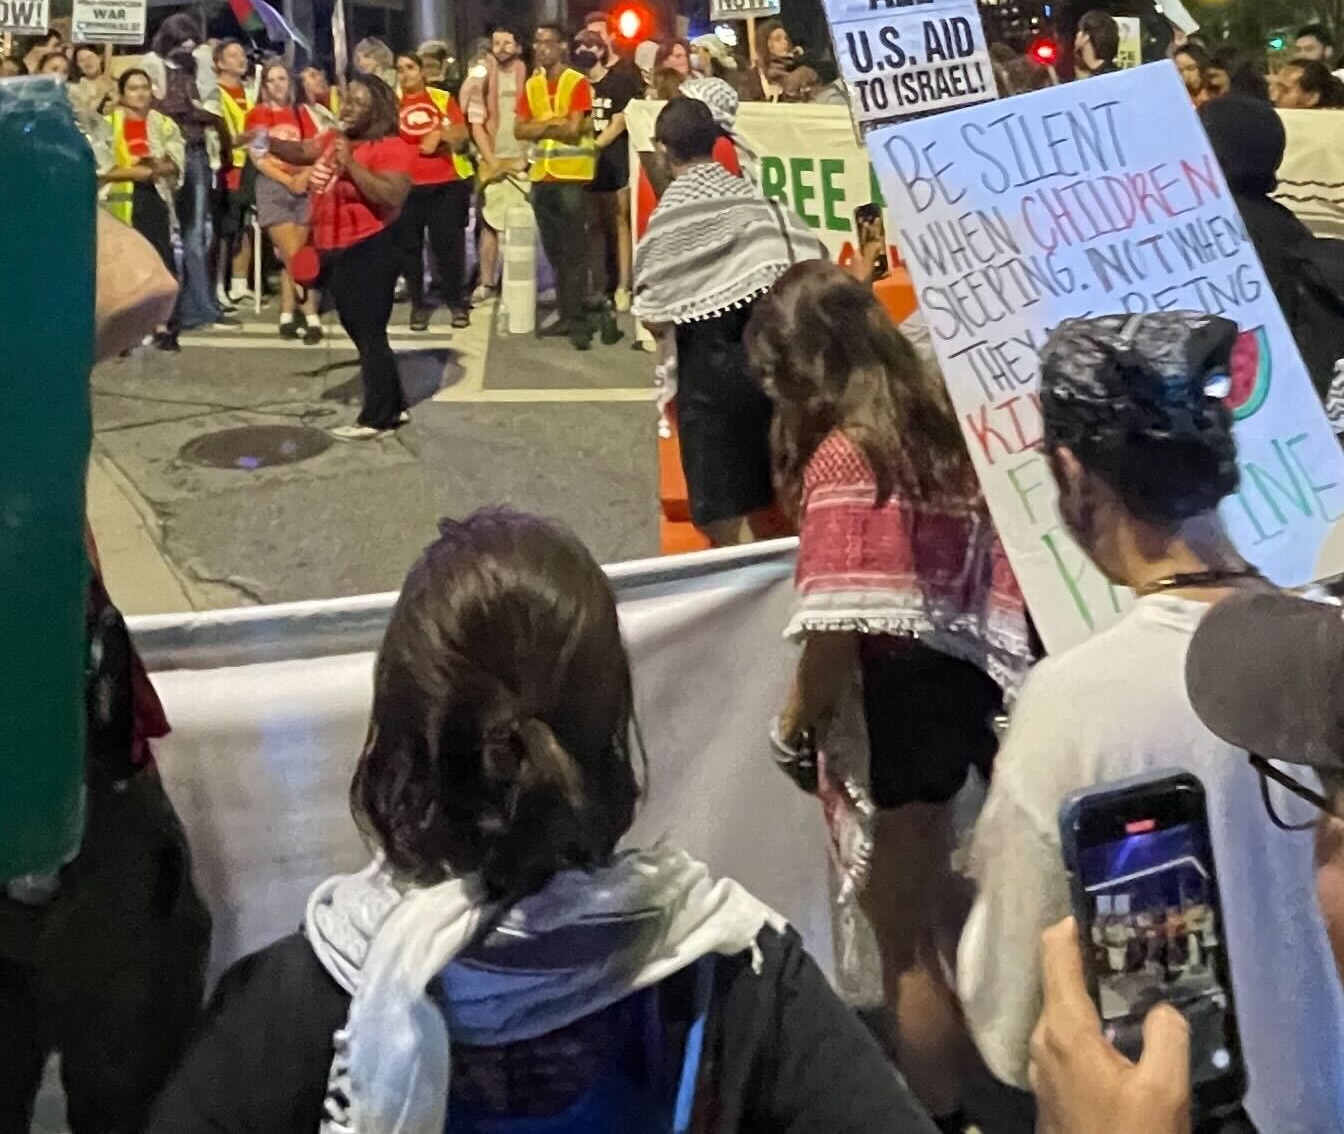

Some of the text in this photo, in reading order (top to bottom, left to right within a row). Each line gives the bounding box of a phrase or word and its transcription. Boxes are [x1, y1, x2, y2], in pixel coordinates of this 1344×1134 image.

[92, 8, 127, 20] WAR
[845, 16, 975, 74] U.S. AID
[854, 61, 986, 112] TO ISRAEL!
[760, 155, 853, 232] REE
[883, 134, 968, 213] BE
[959, 100, 1128, 194] SILENT
[901, 153, 1223, 276] WHEN CHILDREN
[1083, 233, 1173, 293] NOT
[1166, 214, 1249, 272] WHEN
